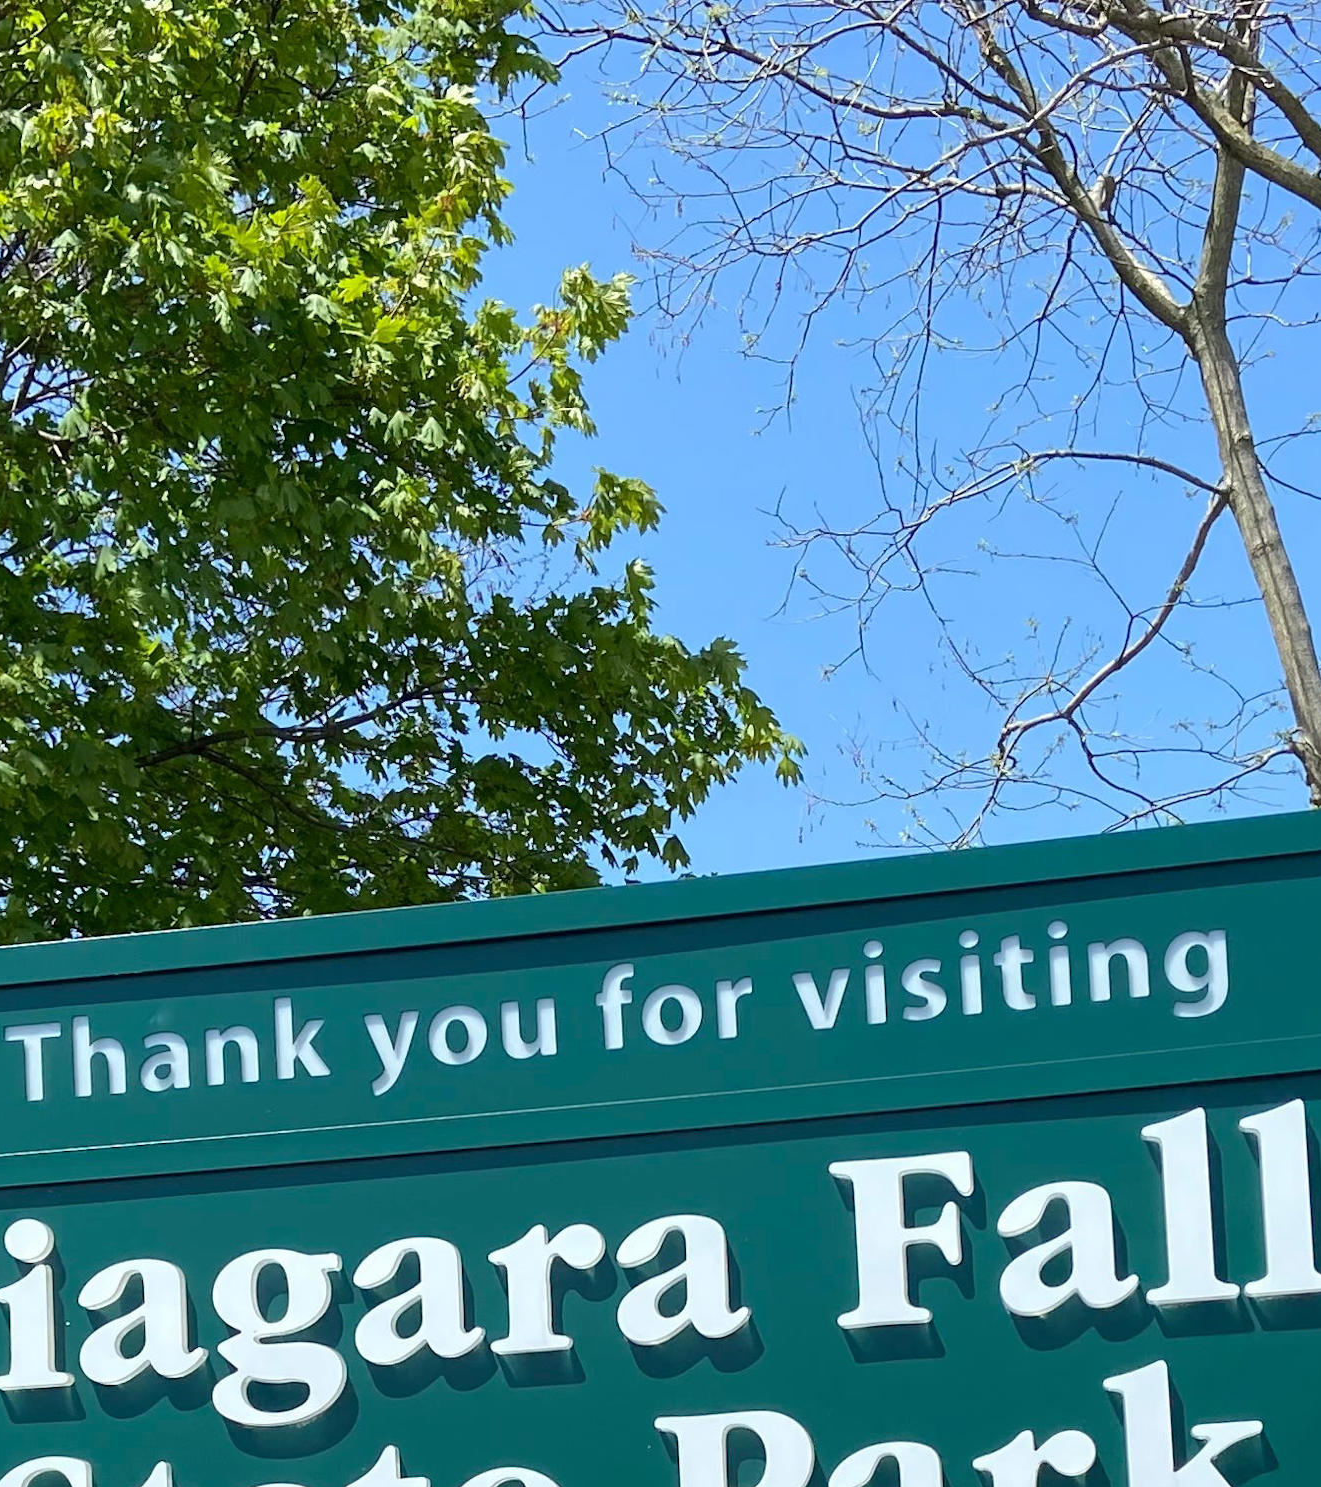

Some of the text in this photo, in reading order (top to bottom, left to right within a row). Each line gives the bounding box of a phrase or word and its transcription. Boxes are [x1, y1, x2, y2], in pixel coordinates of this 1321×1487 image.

[6, 922, 1229, 1101] Thank you for visiting
